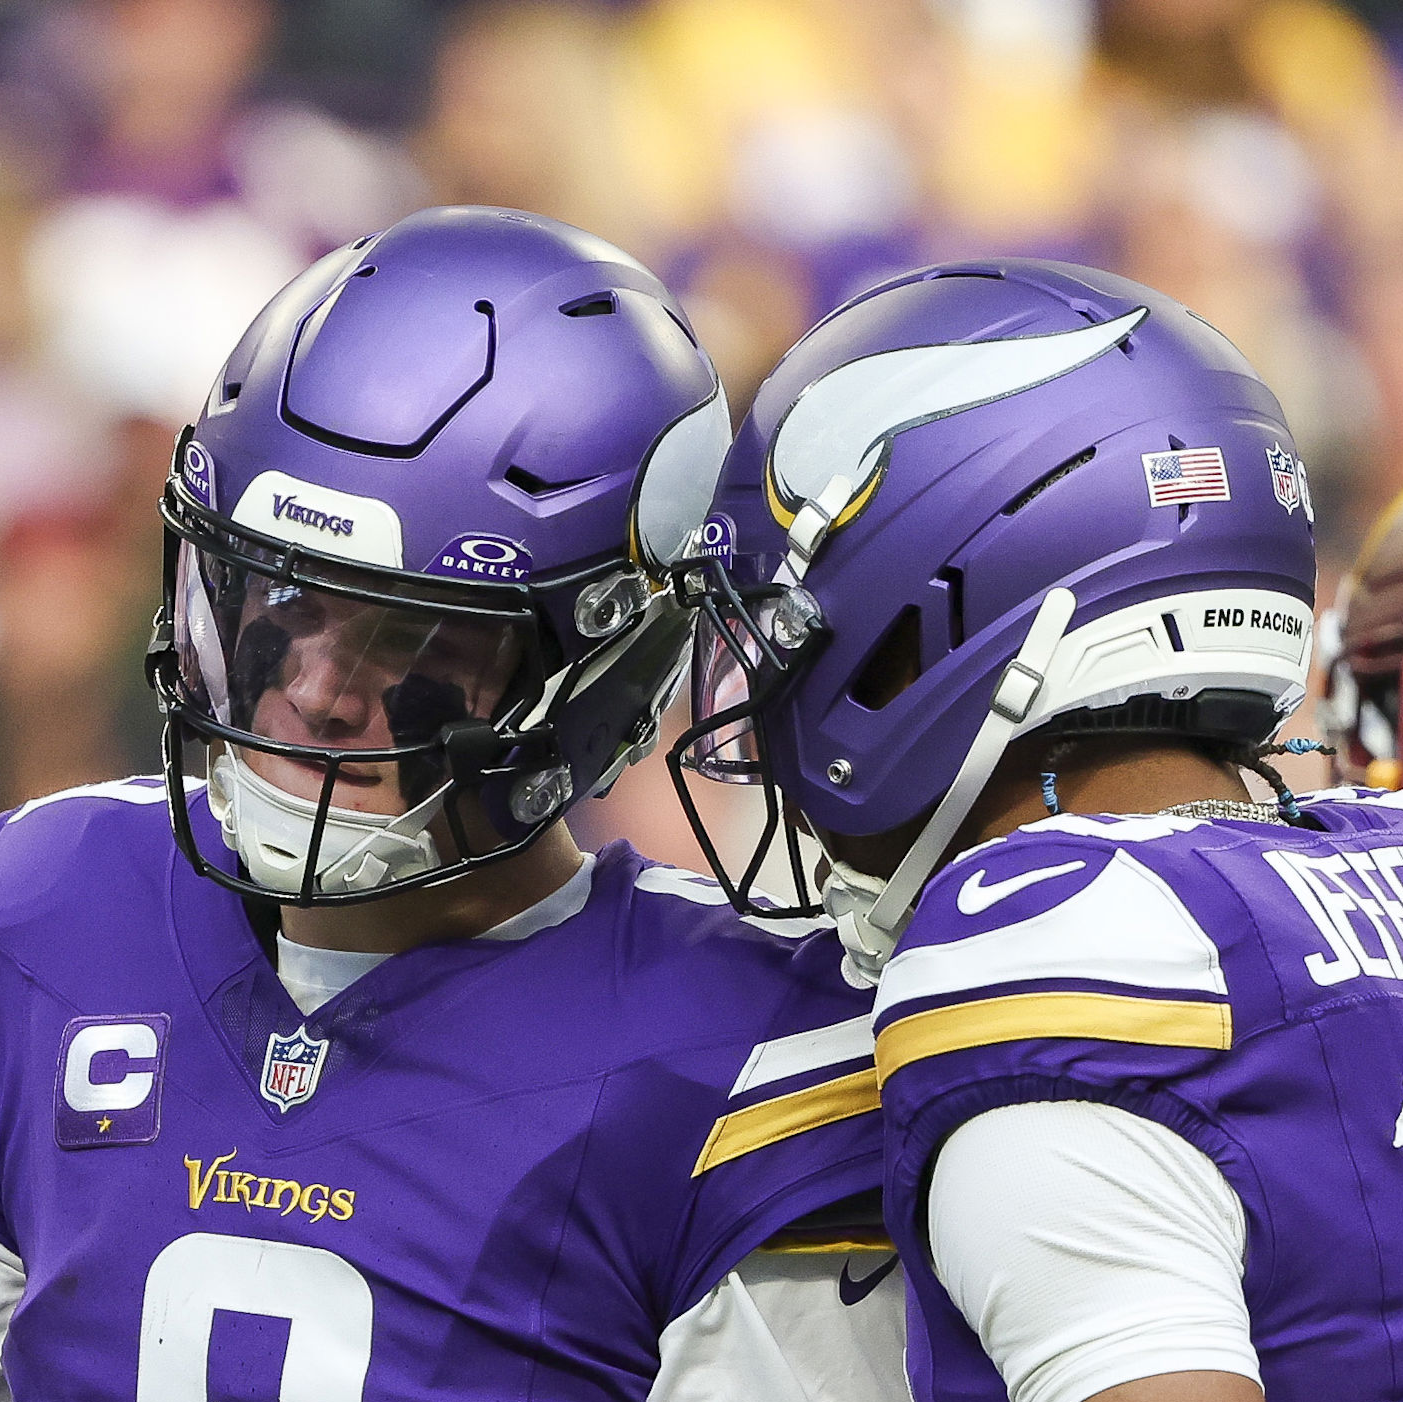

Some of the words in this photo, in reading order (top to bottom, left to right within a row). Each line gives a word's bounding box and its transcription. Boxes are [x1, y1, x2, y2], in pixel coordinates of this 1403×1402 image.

[441, 555, 525, 579] OAKLEY
[1203, 607, 1245, 629] END
[1250, 608, 1303, 640] RACISM
[63, 1023, 159, 1112] C
[269, 1062, 307, 1098] NFL
